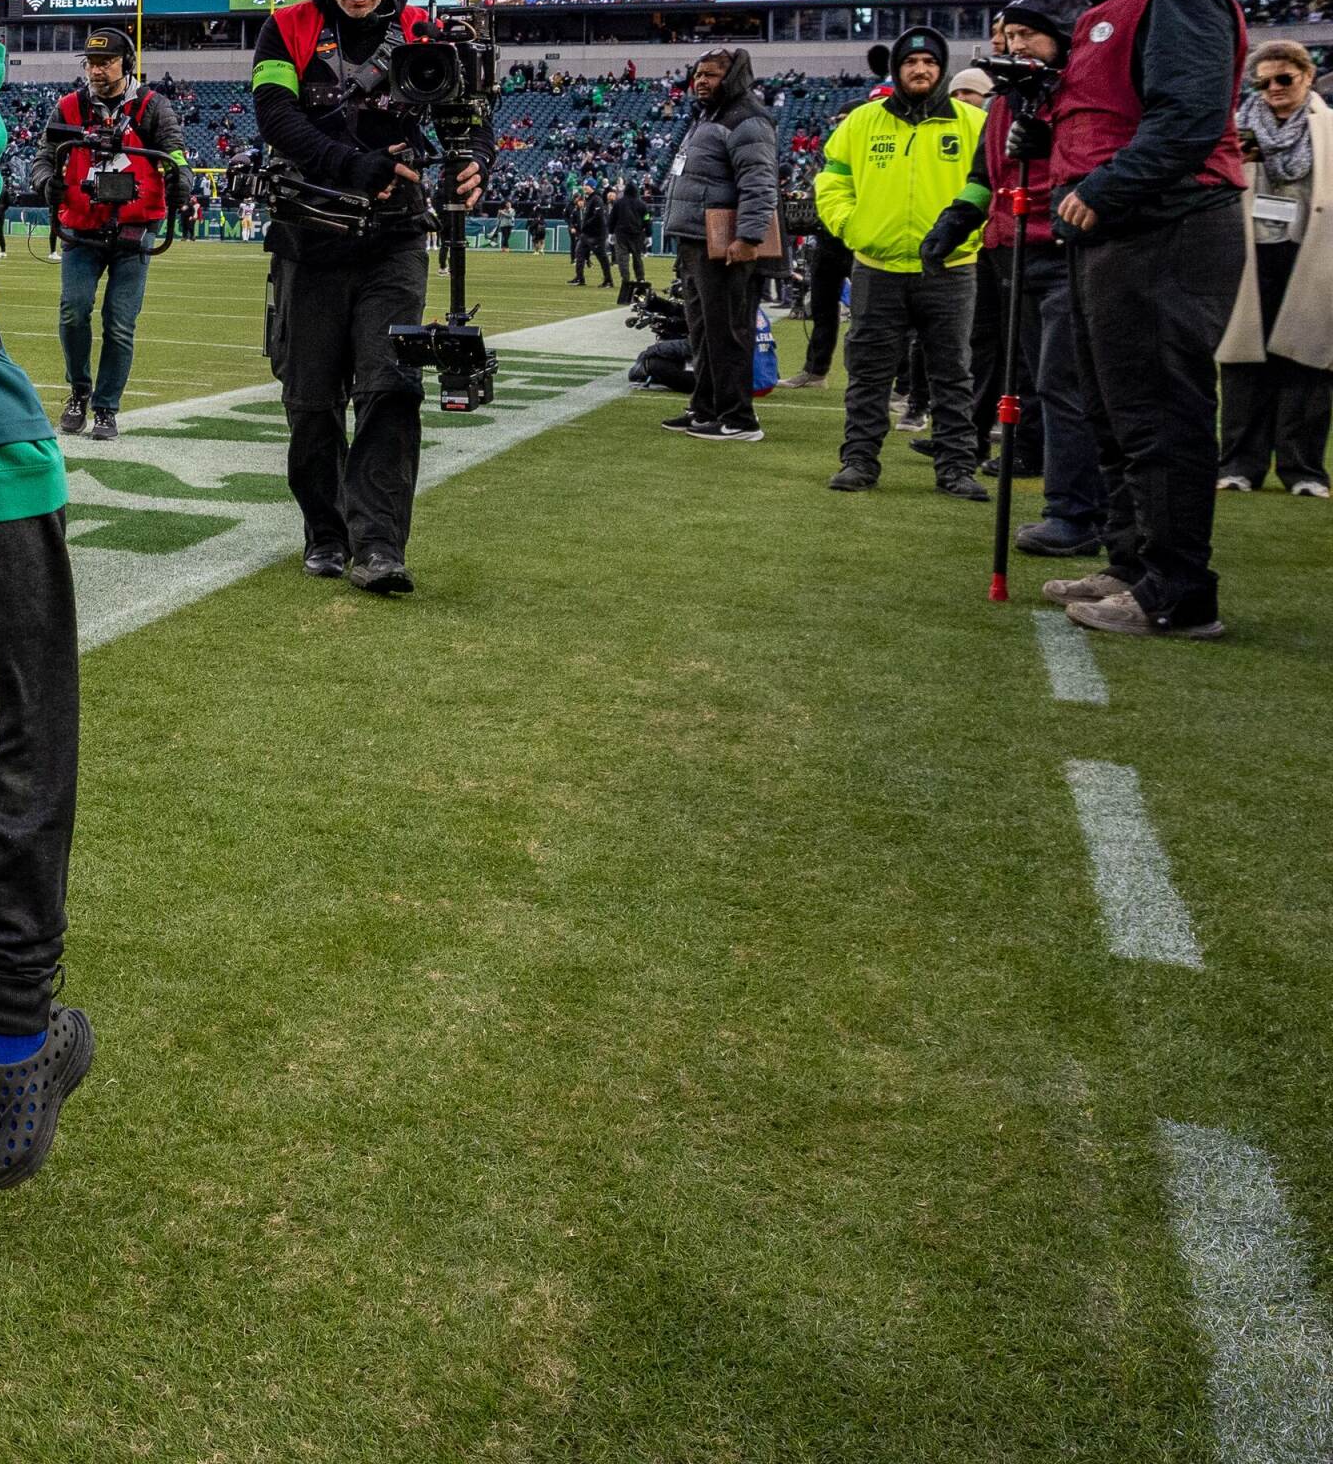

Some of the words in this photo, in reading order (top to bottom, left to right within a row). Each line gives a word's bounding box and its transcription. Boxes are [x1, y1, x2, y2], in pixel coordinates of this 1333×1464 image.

[870, 134, 897, 142] EVENT
[870, 142, 896, 153] 4016
[869, 154, 895, 162] STAFF
